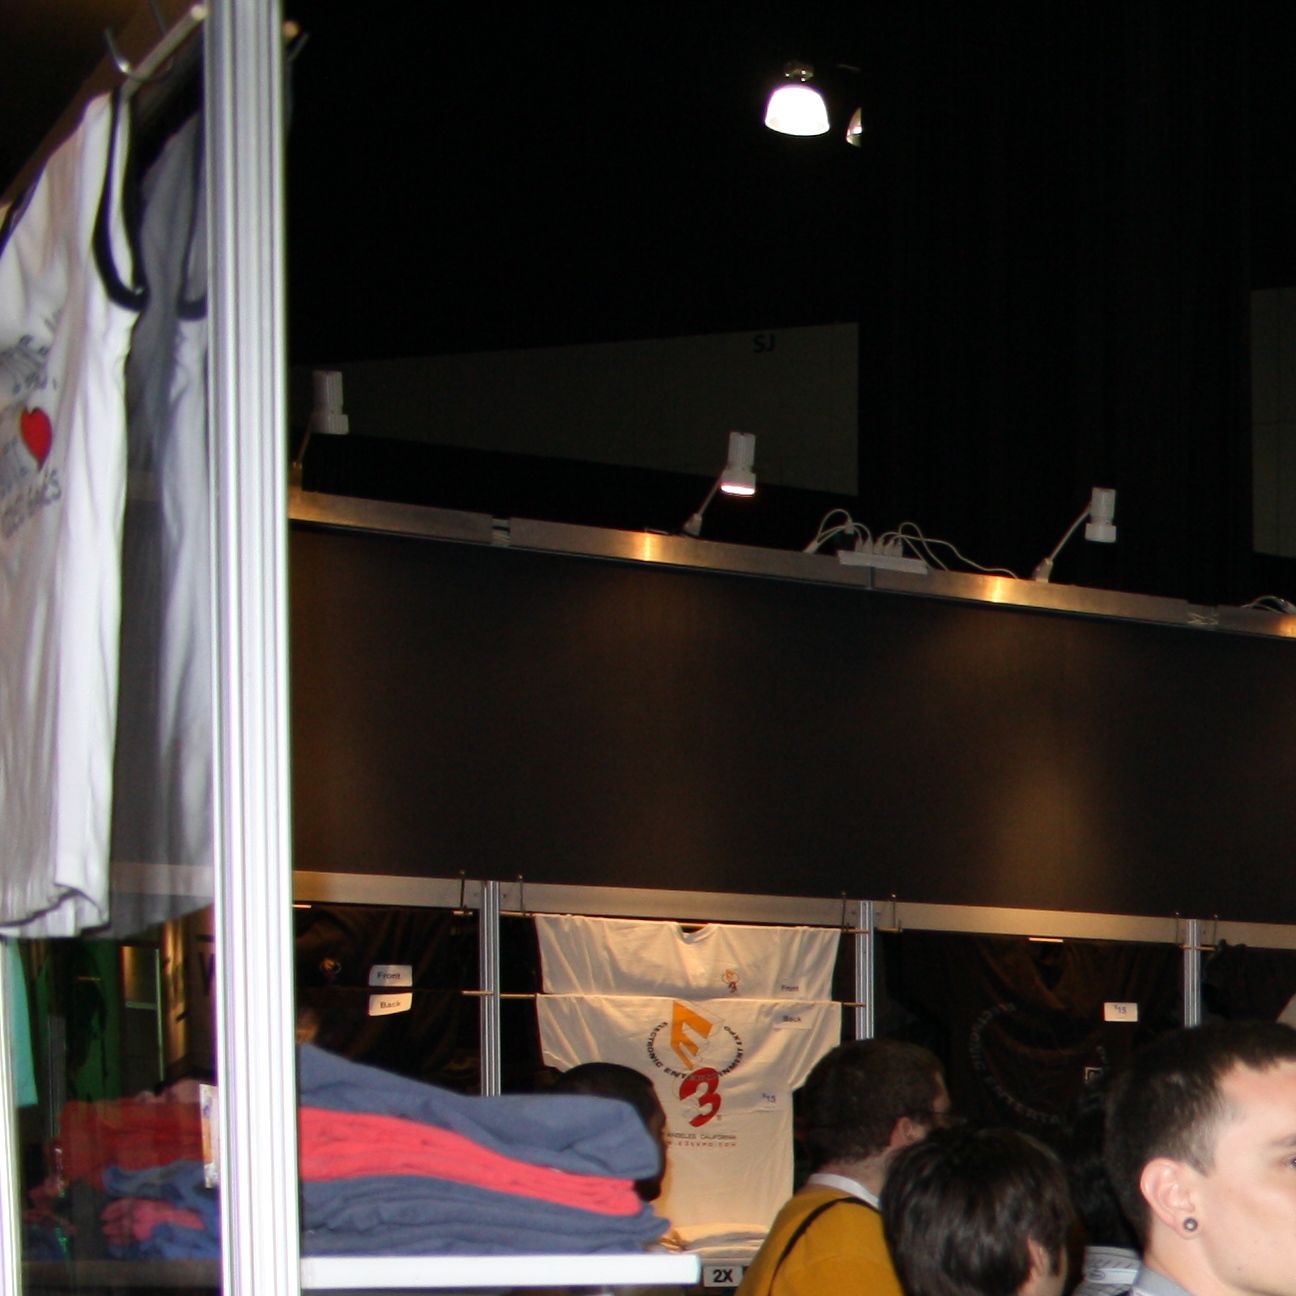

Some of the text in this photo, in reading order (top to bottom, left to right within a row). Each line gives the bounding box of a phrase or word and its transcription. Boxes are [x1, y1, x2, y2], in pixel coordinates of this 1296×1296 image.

[753, 333, 775, 353] SJ
[376, 970, 402, 981] Front
[379, 1001, 401, 1009] Back
[713, 1269, 733, 1283] 2X
